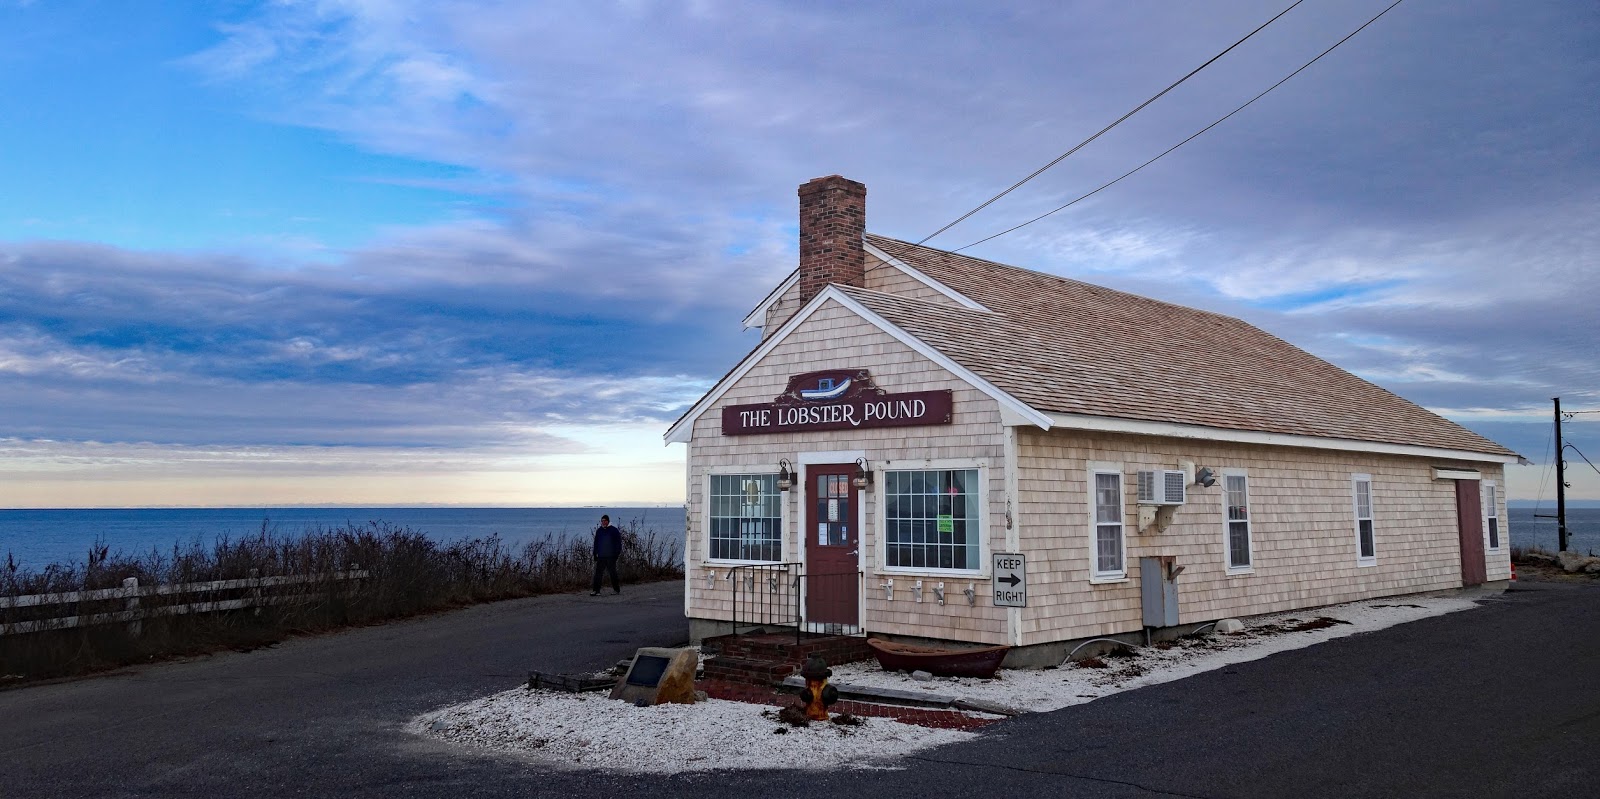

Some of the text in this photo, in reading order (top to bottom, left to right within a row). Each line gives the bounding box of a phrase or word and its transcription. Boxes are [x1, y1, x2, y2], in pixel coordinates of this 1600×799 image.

[740, 399, 926, 427] THE LOBSTER POUND
[996, 559, 1021, 570] KEEP
[996, 590, 1024, 602] RIGHT
